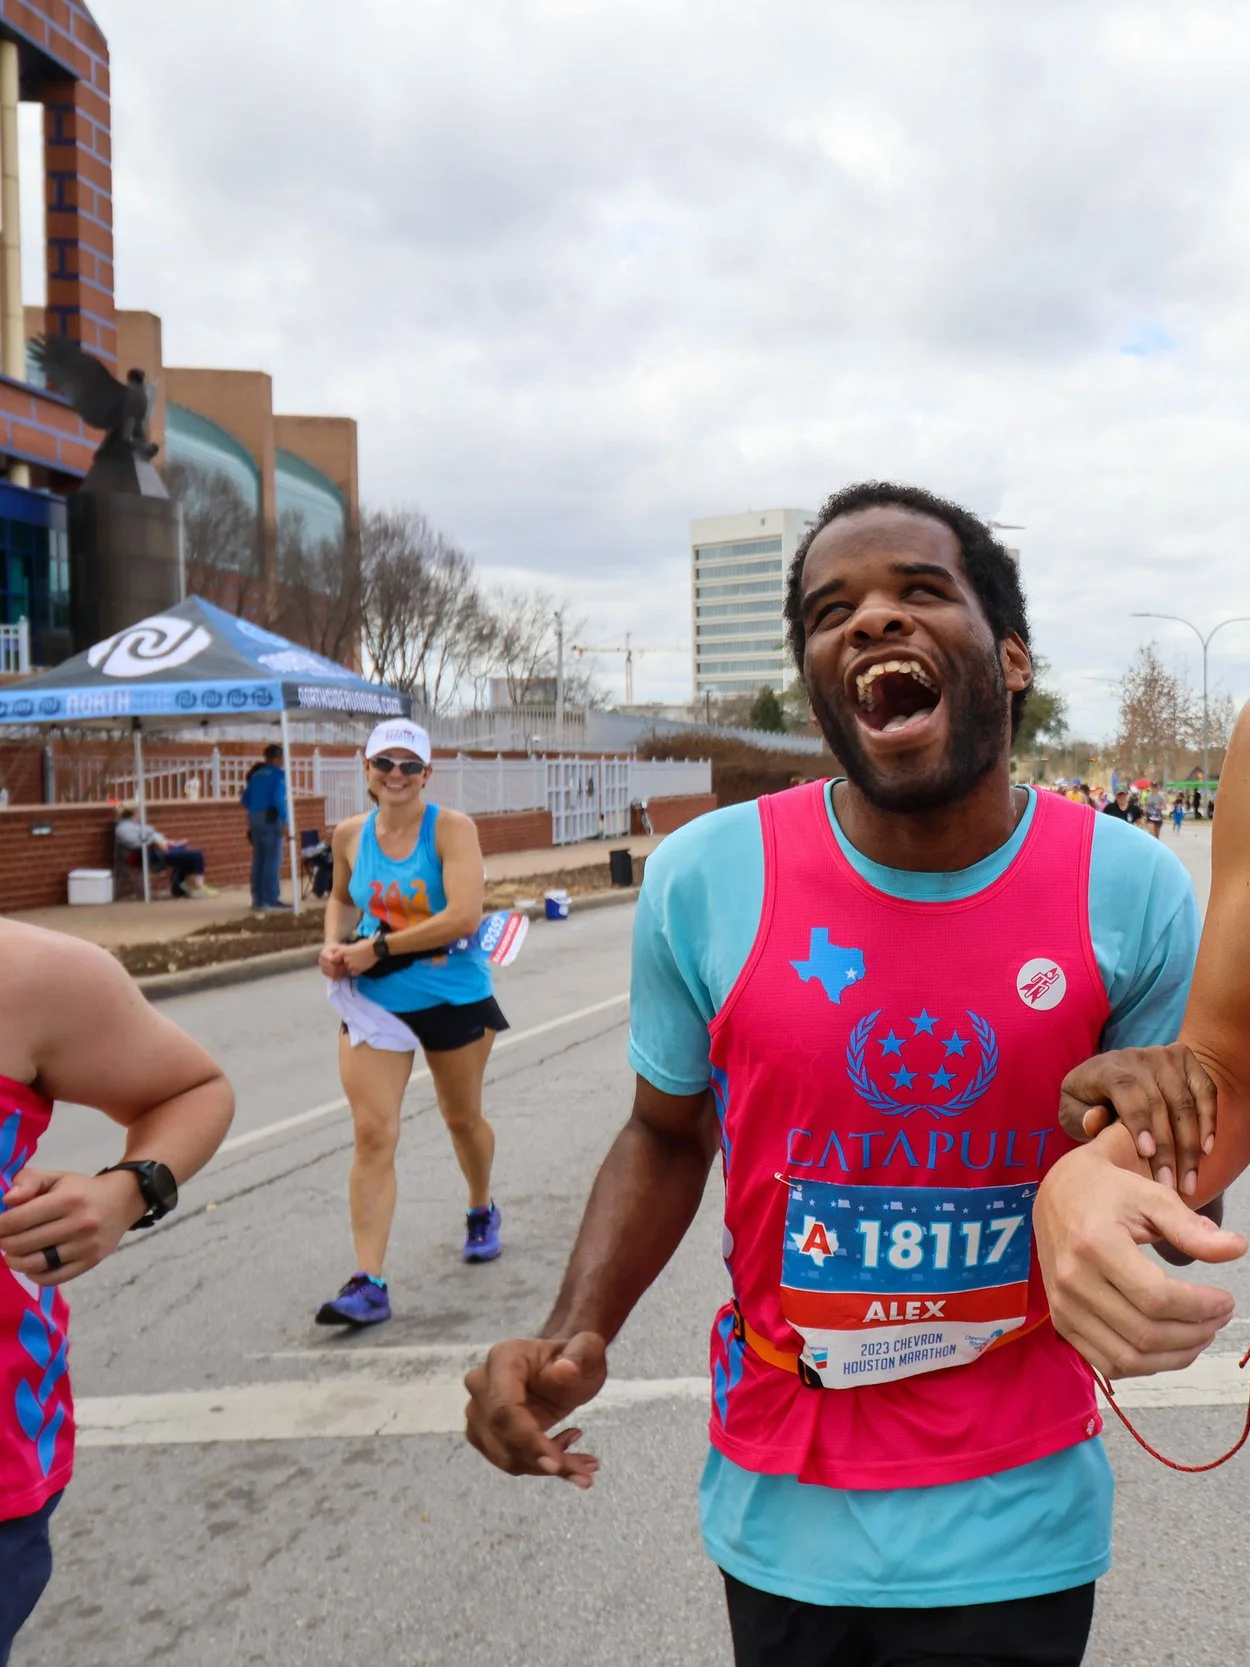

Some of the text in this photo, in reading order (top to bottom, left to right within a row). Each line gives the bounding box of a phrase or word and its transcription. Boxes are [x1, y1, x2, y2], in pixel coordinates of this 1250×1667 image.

[787, 1128, 1054, 1172] CATAPULT
[801, 1213, 1026, 1271] A 18117
[862, 1300, 947, 1323] ALEX
[843, 1356, 896, 1375] HOUSTON
[899, 1344, 957, 1366] MARATHON
[860, 1333, 943, 1357] 2023 CHEVRON
